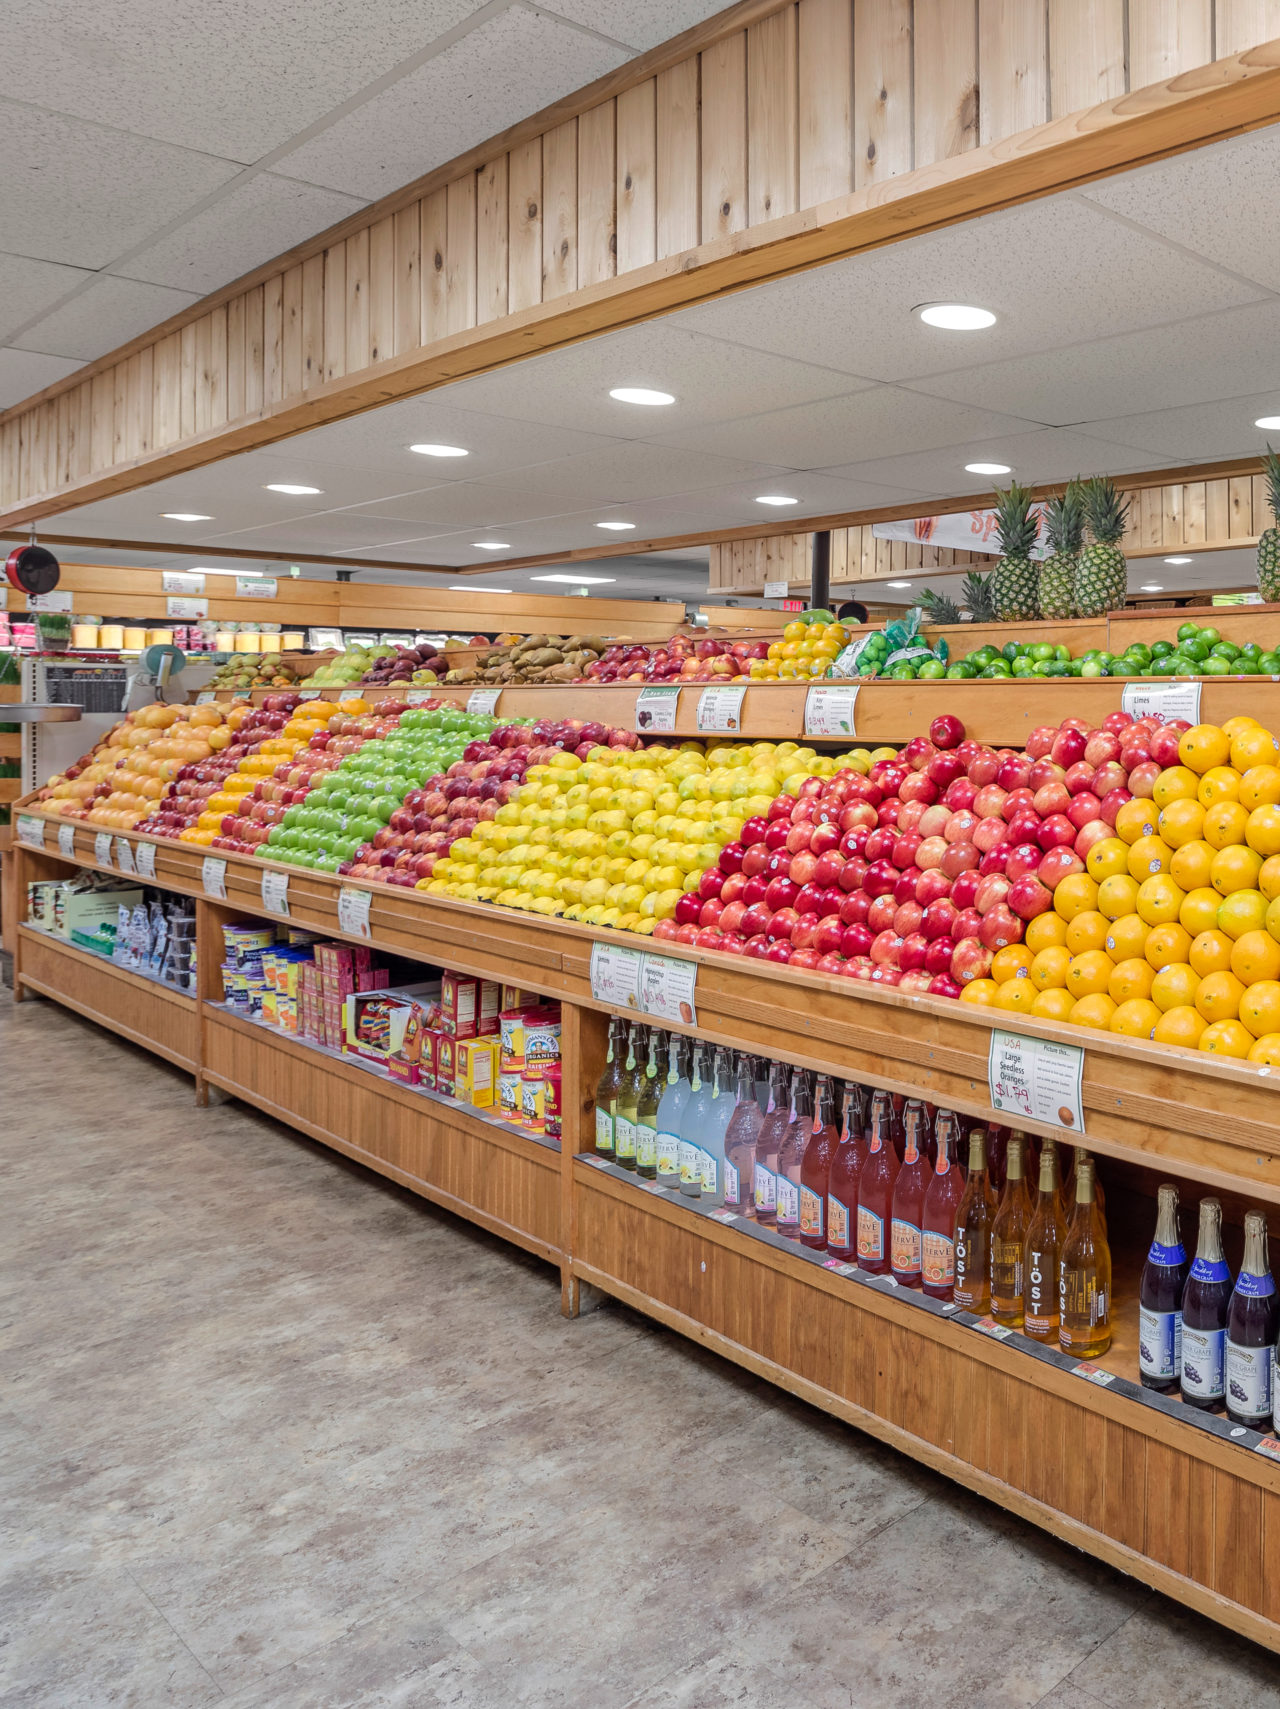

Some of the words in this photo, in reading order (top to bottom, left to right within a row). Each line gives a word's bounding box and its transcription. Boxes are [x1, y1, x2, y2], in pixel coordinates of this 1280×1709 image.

[783, 599, 803, 612] EXIT
[1004, 1036, 1021, 1050] USA
[1043, 1044, 1059, 1055] Picture
[1005, 1051, 1021, 1064] Large
[999, 1061, 1025, 1075] Seedless
[999, 1071, 1025, 1086] Oranges
[995, 1081, 1029, 1101] $1.79
[956, 1226, 967, 1288] TÖST
[1030, 1251, 1043, 1316] TÖST
[1059, 1260, 1067, 1327] TÖST
